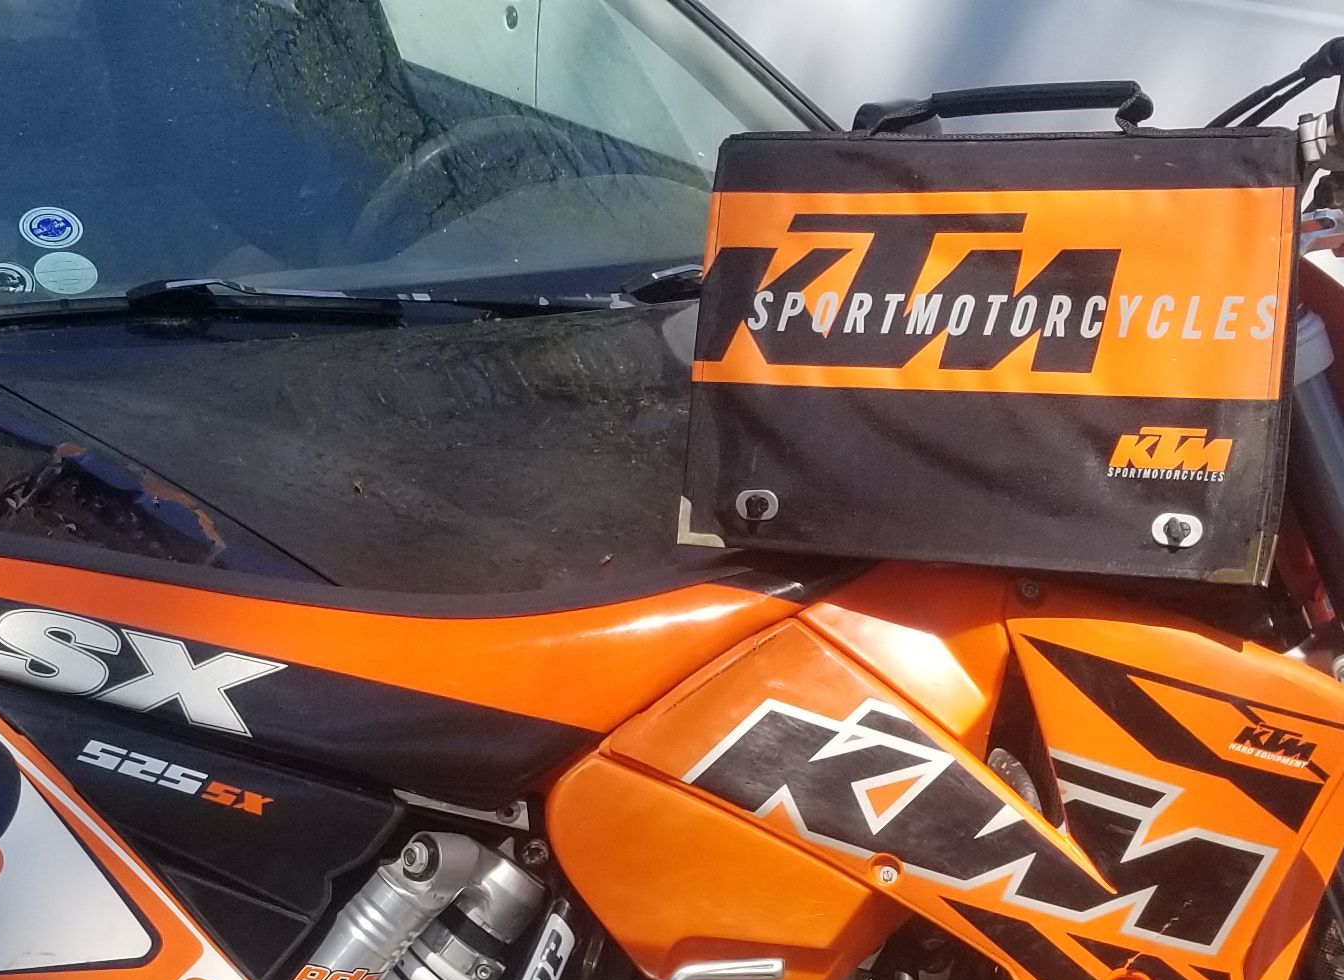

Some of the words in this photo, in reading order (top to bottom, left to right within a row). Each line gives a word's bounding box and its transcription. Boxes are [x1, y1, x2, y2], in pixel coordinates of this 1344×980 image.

[693, 213, 1121, 373] KTM
[746, 290, 1279, 341] SPORTMOTORCYCLES
[1109, 426, 1233, 472] KTM
[1107, 467, 1225, 482] SPORTMOTORCYCLES
[1233, 723, 1318, 762] KTM
[683, 698, 1278, 955] KTM
